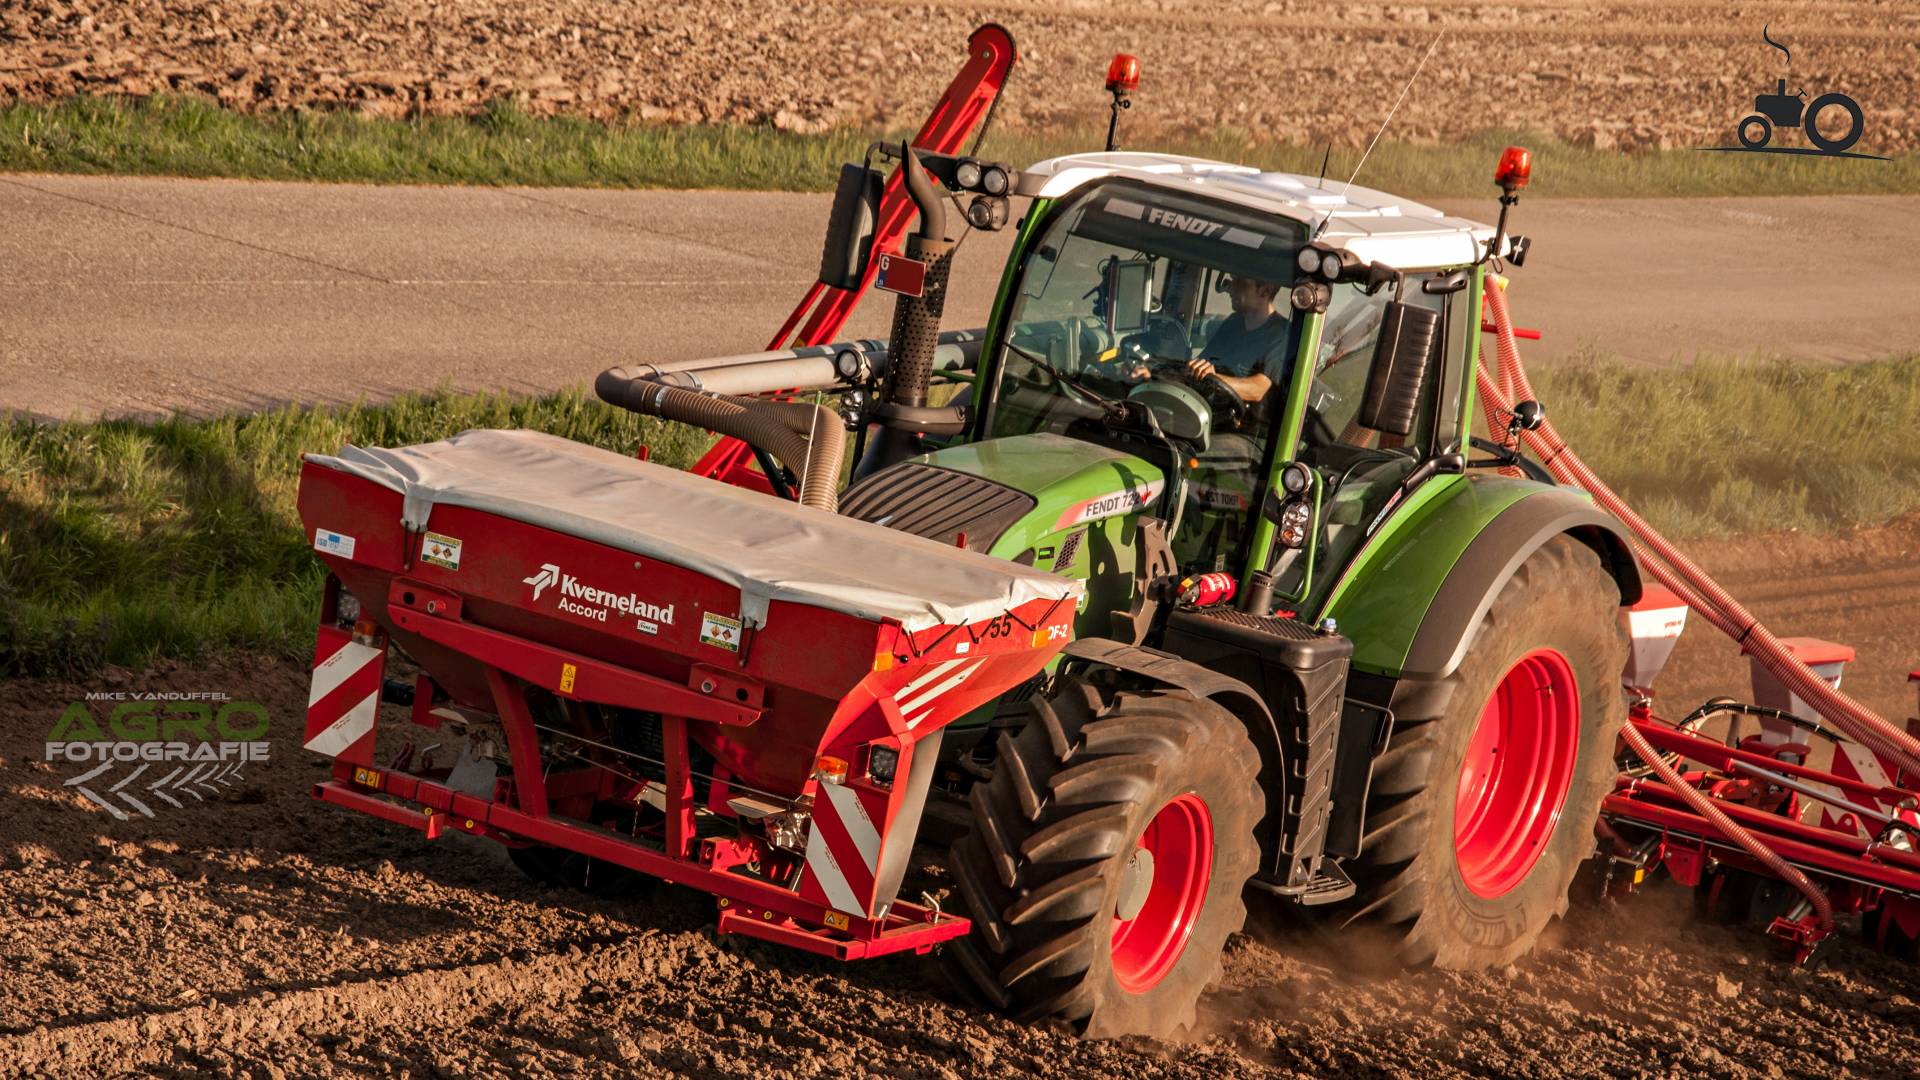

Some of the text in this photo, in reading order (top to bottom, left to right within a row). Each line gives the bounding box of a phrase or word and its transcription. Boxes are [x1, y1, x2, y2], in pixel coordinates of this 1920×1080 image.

[1148, 207, 1224, 237] FENDT
[1086, 496, 1121, 517] FENDT
[558, 597, 607, 622] Accord
[560, 574, 675, 625] Kverneland
